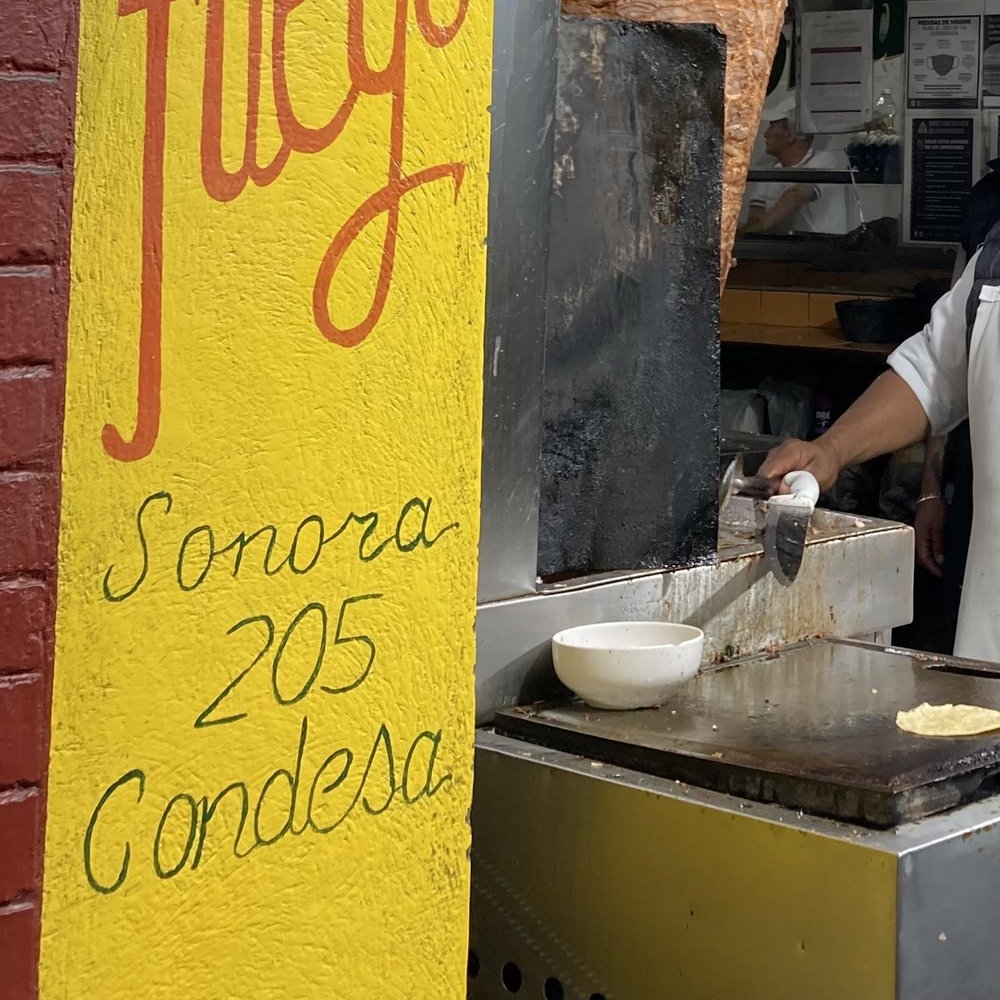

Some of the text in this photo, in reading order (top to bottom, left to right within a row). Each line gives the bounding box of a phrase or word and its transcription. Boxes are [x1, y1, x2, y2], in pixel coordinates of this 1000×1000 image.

[103, 490, 459, 602] Sonora
[194, 593, 384, 728] 205
[84, 716, 453, 895] Condesa
